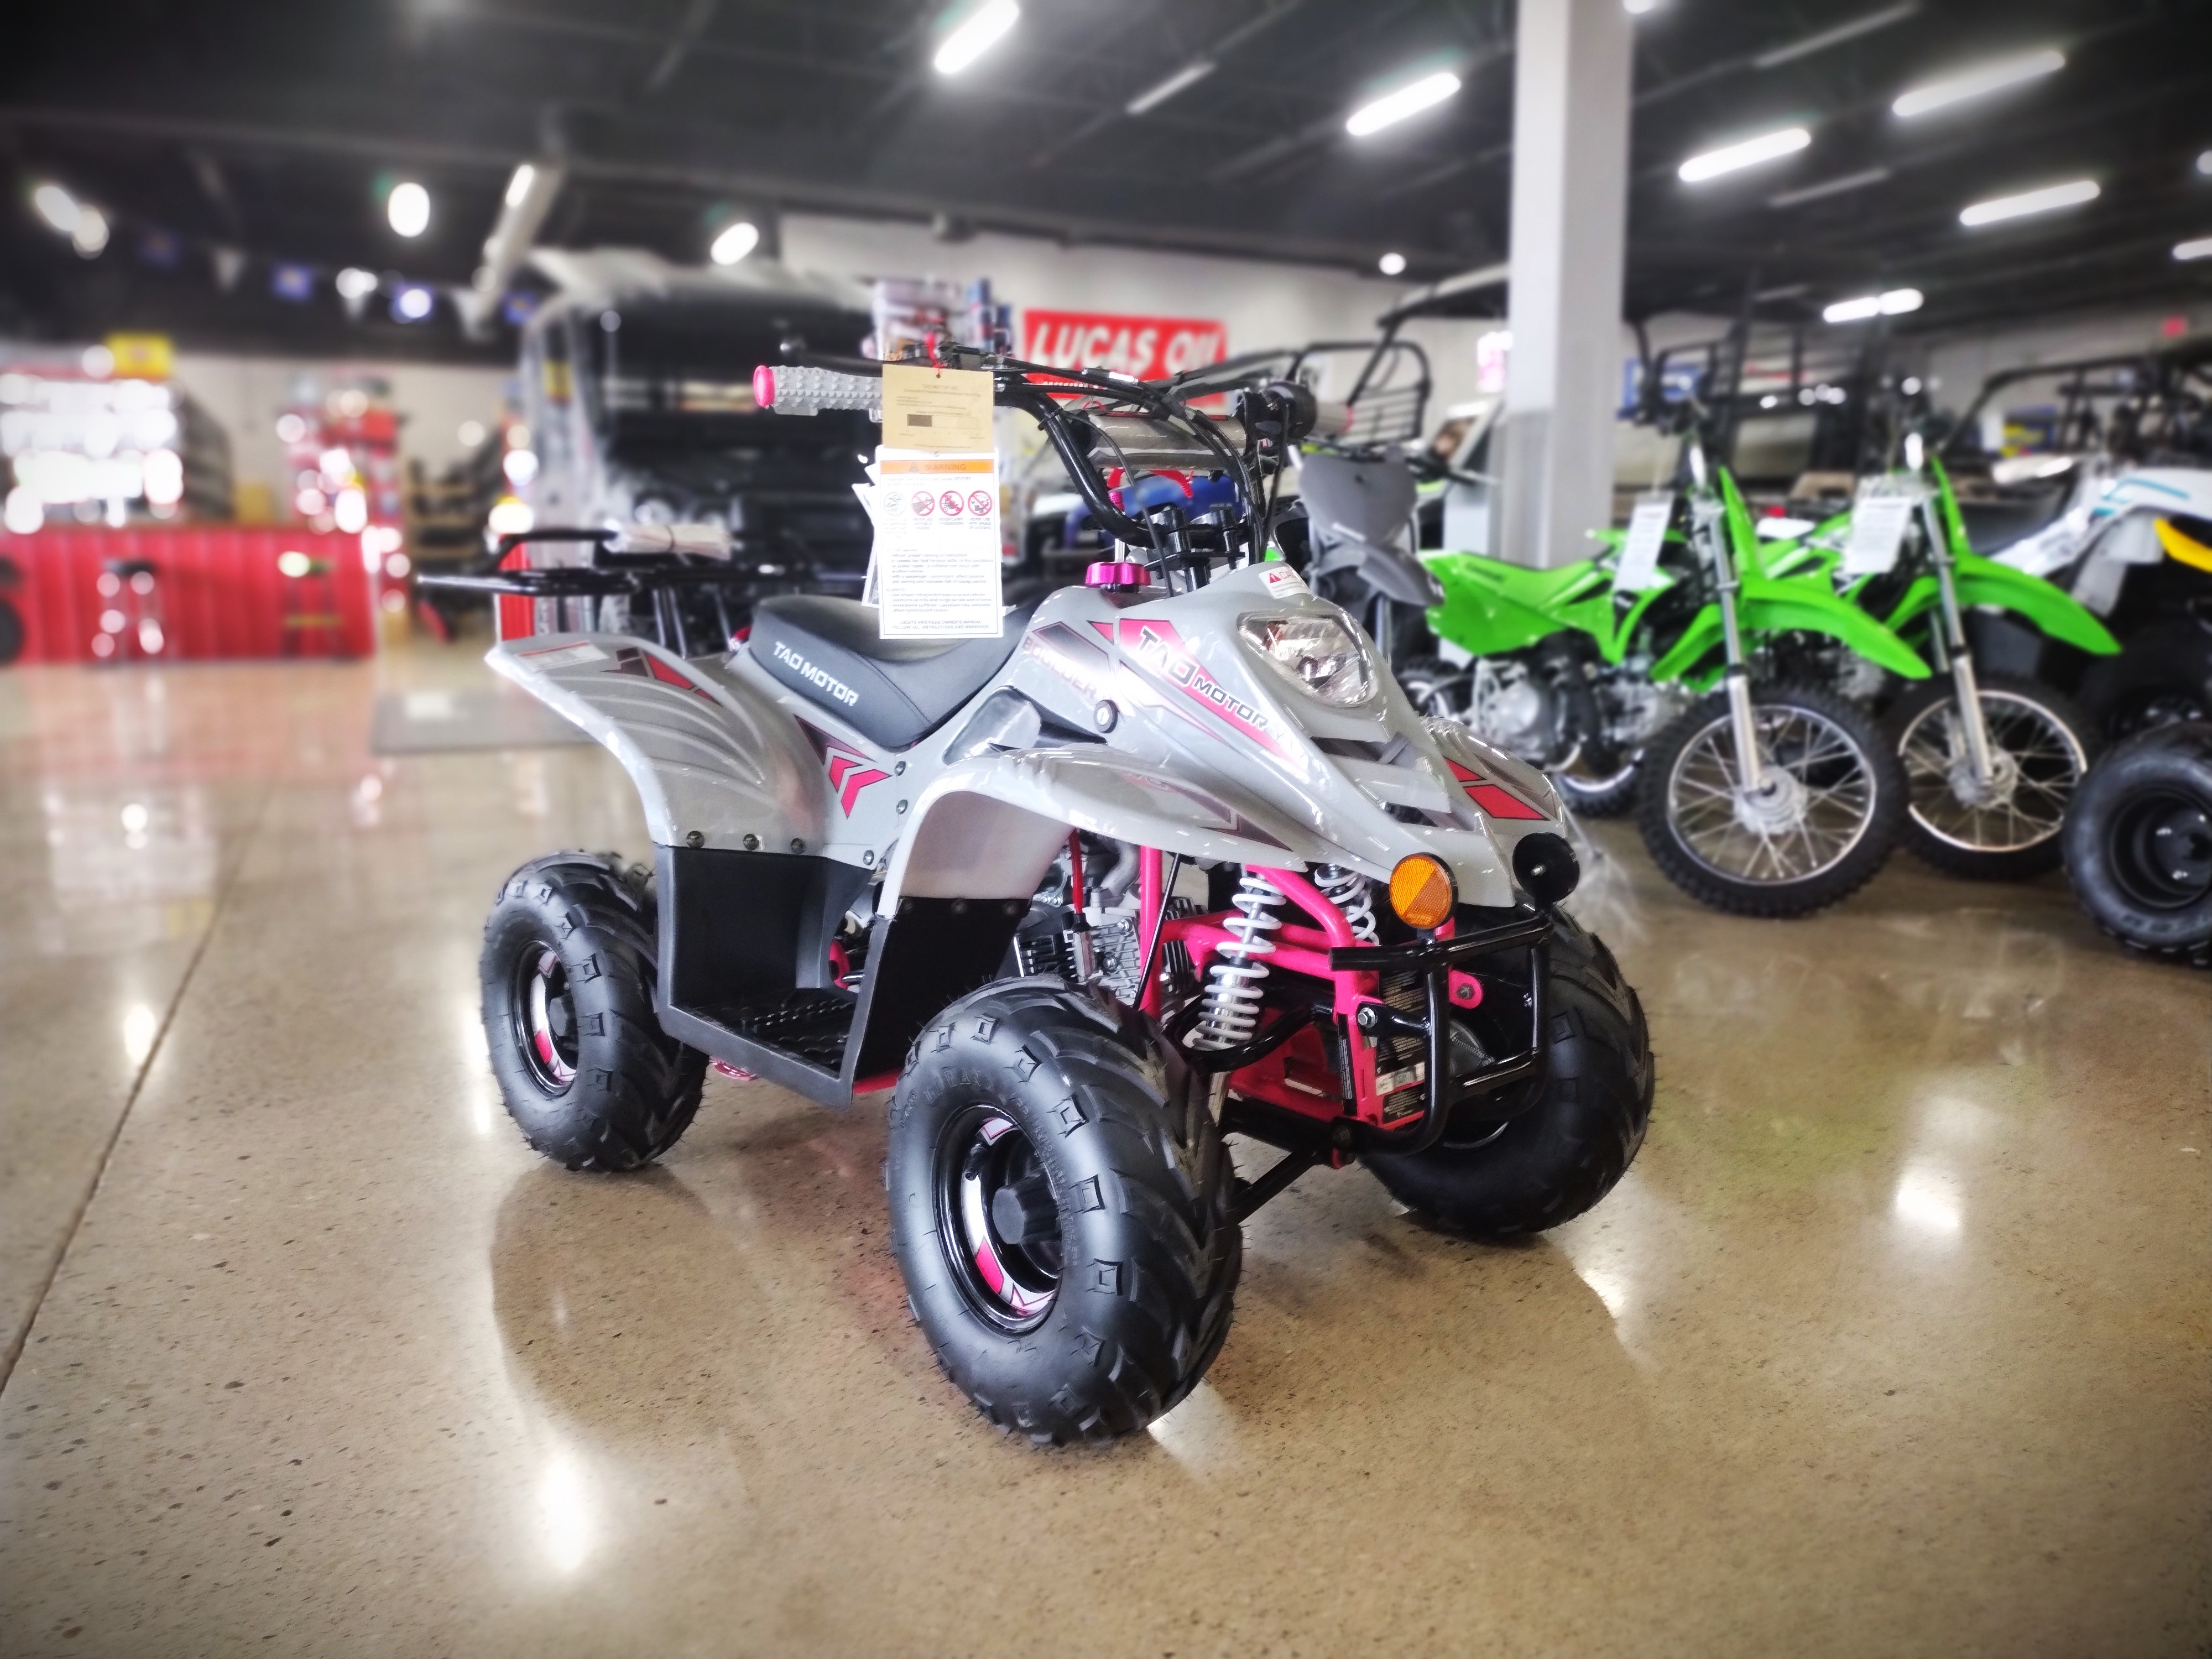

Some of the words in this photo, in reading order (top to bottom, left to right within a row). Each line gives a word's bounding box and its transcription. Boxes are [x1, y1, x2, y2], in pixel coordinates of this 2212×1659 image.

[1029, 322, 1158, 371] LUCAS
[773, 641, 804, 670] TAO
[801, 661, 859, 707] MOTOR
[1136, 627, 1199, 686] TAO
[1193, 676, 1270, 729] MOTOR
